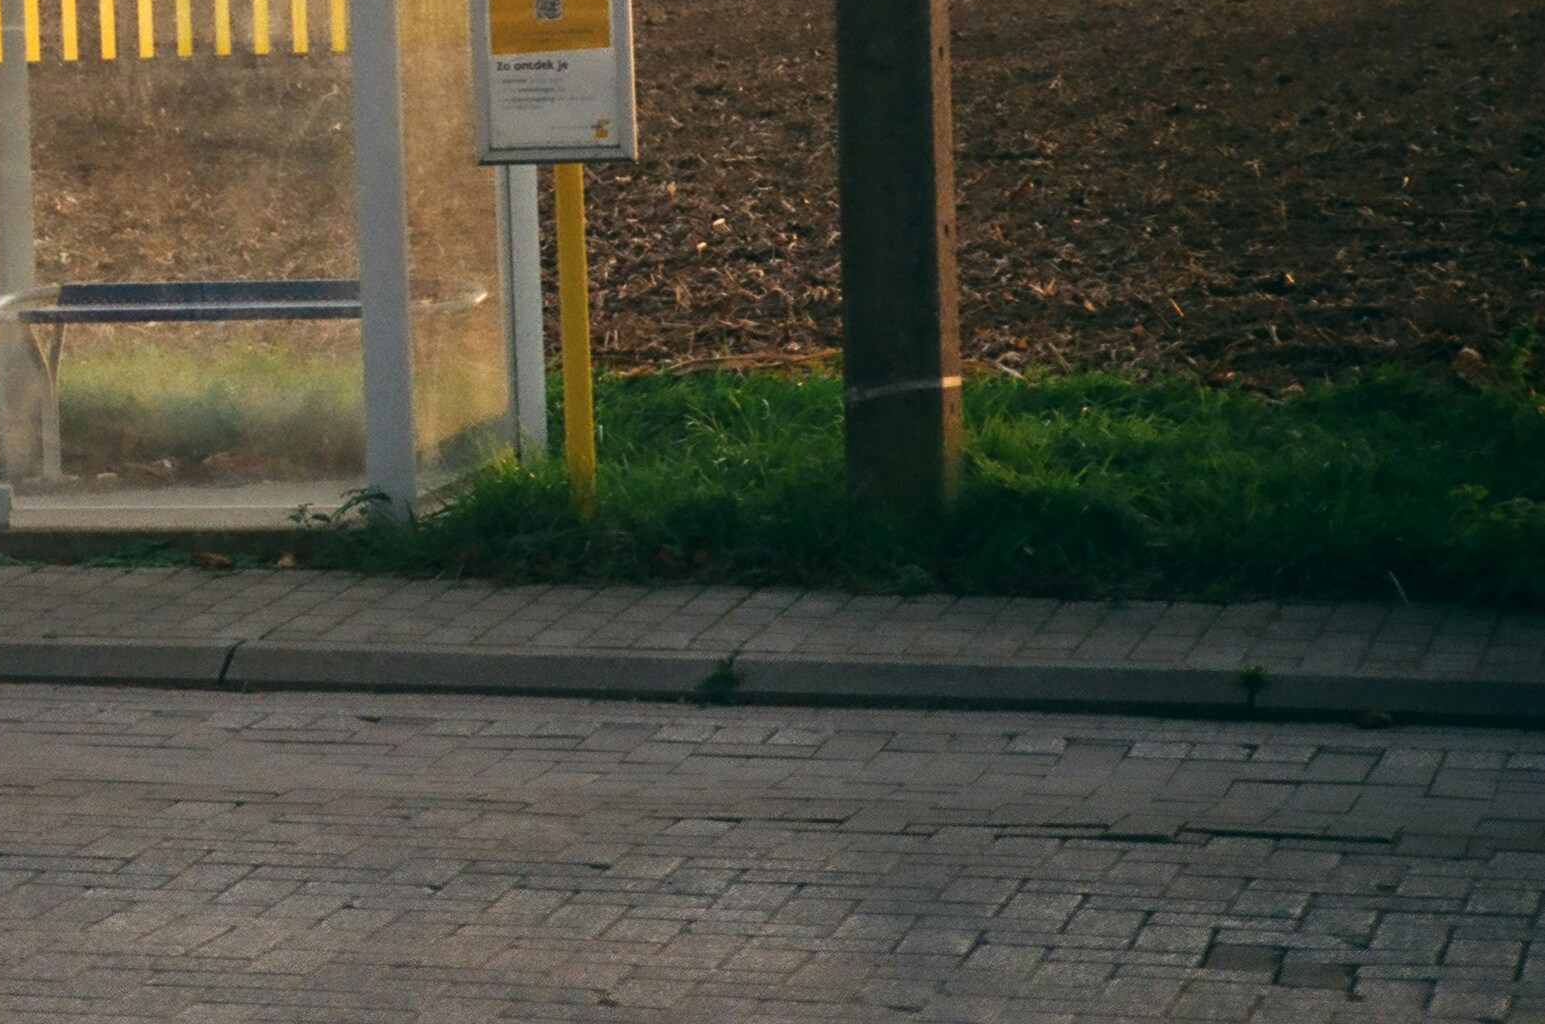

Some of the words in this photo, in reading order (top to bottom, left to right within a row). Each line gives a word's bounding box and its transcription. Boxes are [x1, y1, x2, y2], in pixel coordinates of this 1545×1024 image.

[497, 62, 510, 72] Zo
[514, 60, 554, 71] ontdek
[557, 60, 568, 73] je
